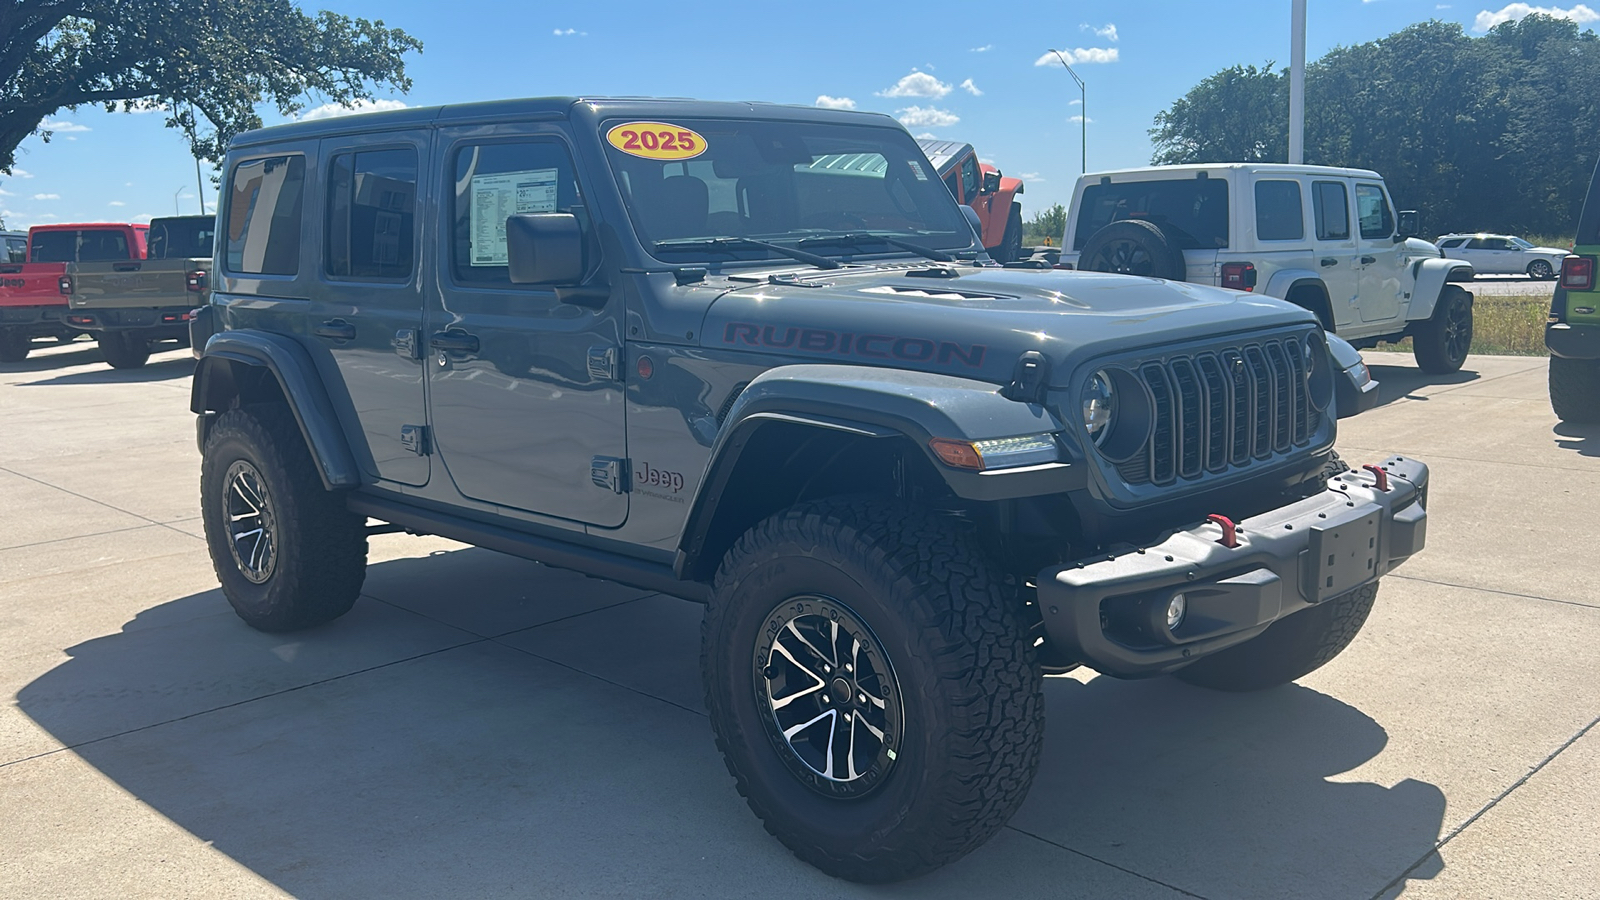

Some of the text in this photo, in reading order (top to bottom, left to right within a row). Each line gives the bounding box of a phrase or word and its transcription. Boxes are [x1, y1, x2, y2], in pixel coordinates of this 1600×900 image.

[620, 130, 696, 152] 2025
[722, 321, 988, 369] RUBICON
[635, 461, 684, 494] Jeep
